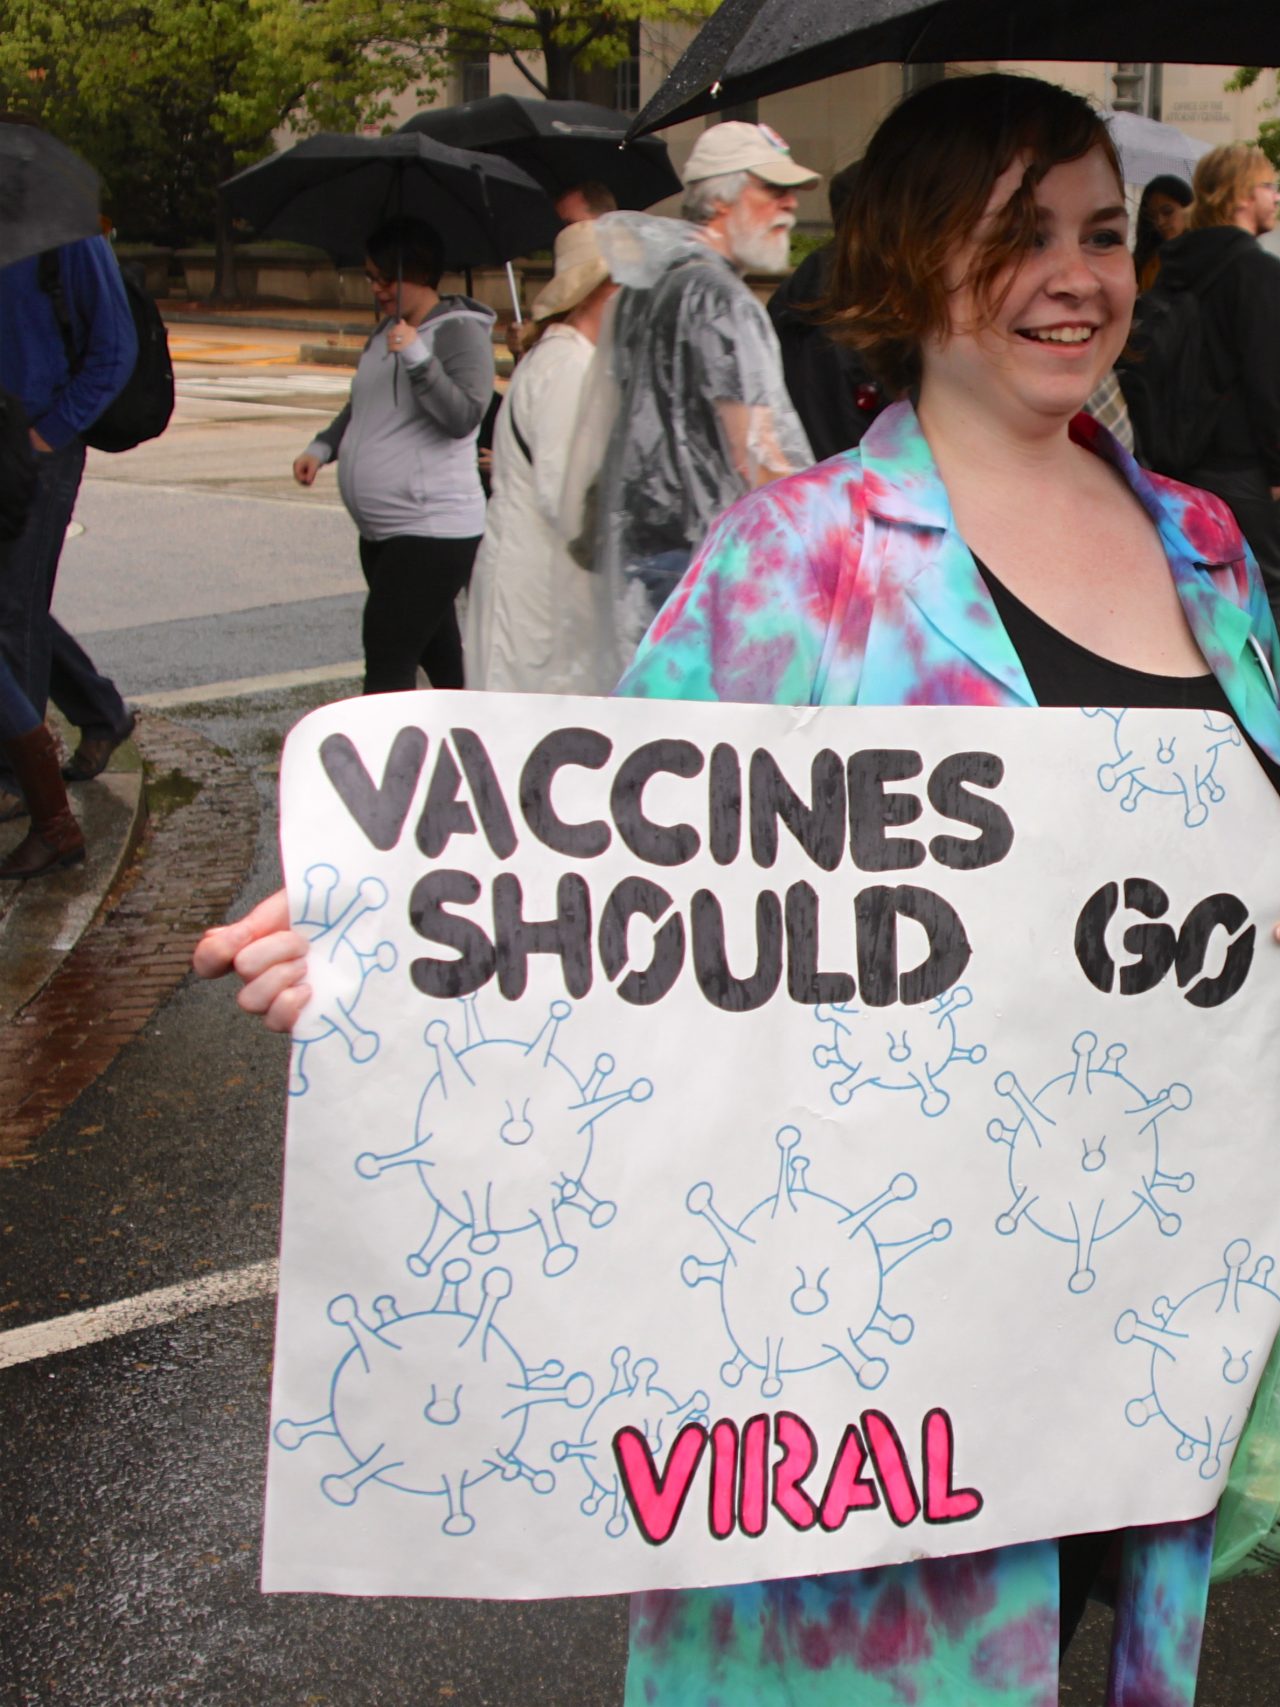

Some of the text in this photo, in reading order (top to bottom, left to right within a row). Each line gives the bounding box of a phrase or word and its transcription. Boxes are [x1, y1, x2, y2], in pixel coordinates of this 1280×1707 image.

[321, 727, 1014, 872] VACCINES
[410, 868, 1257, 1012] SHOULD GO
[611, 1407, 984, 1547] VIRAL
